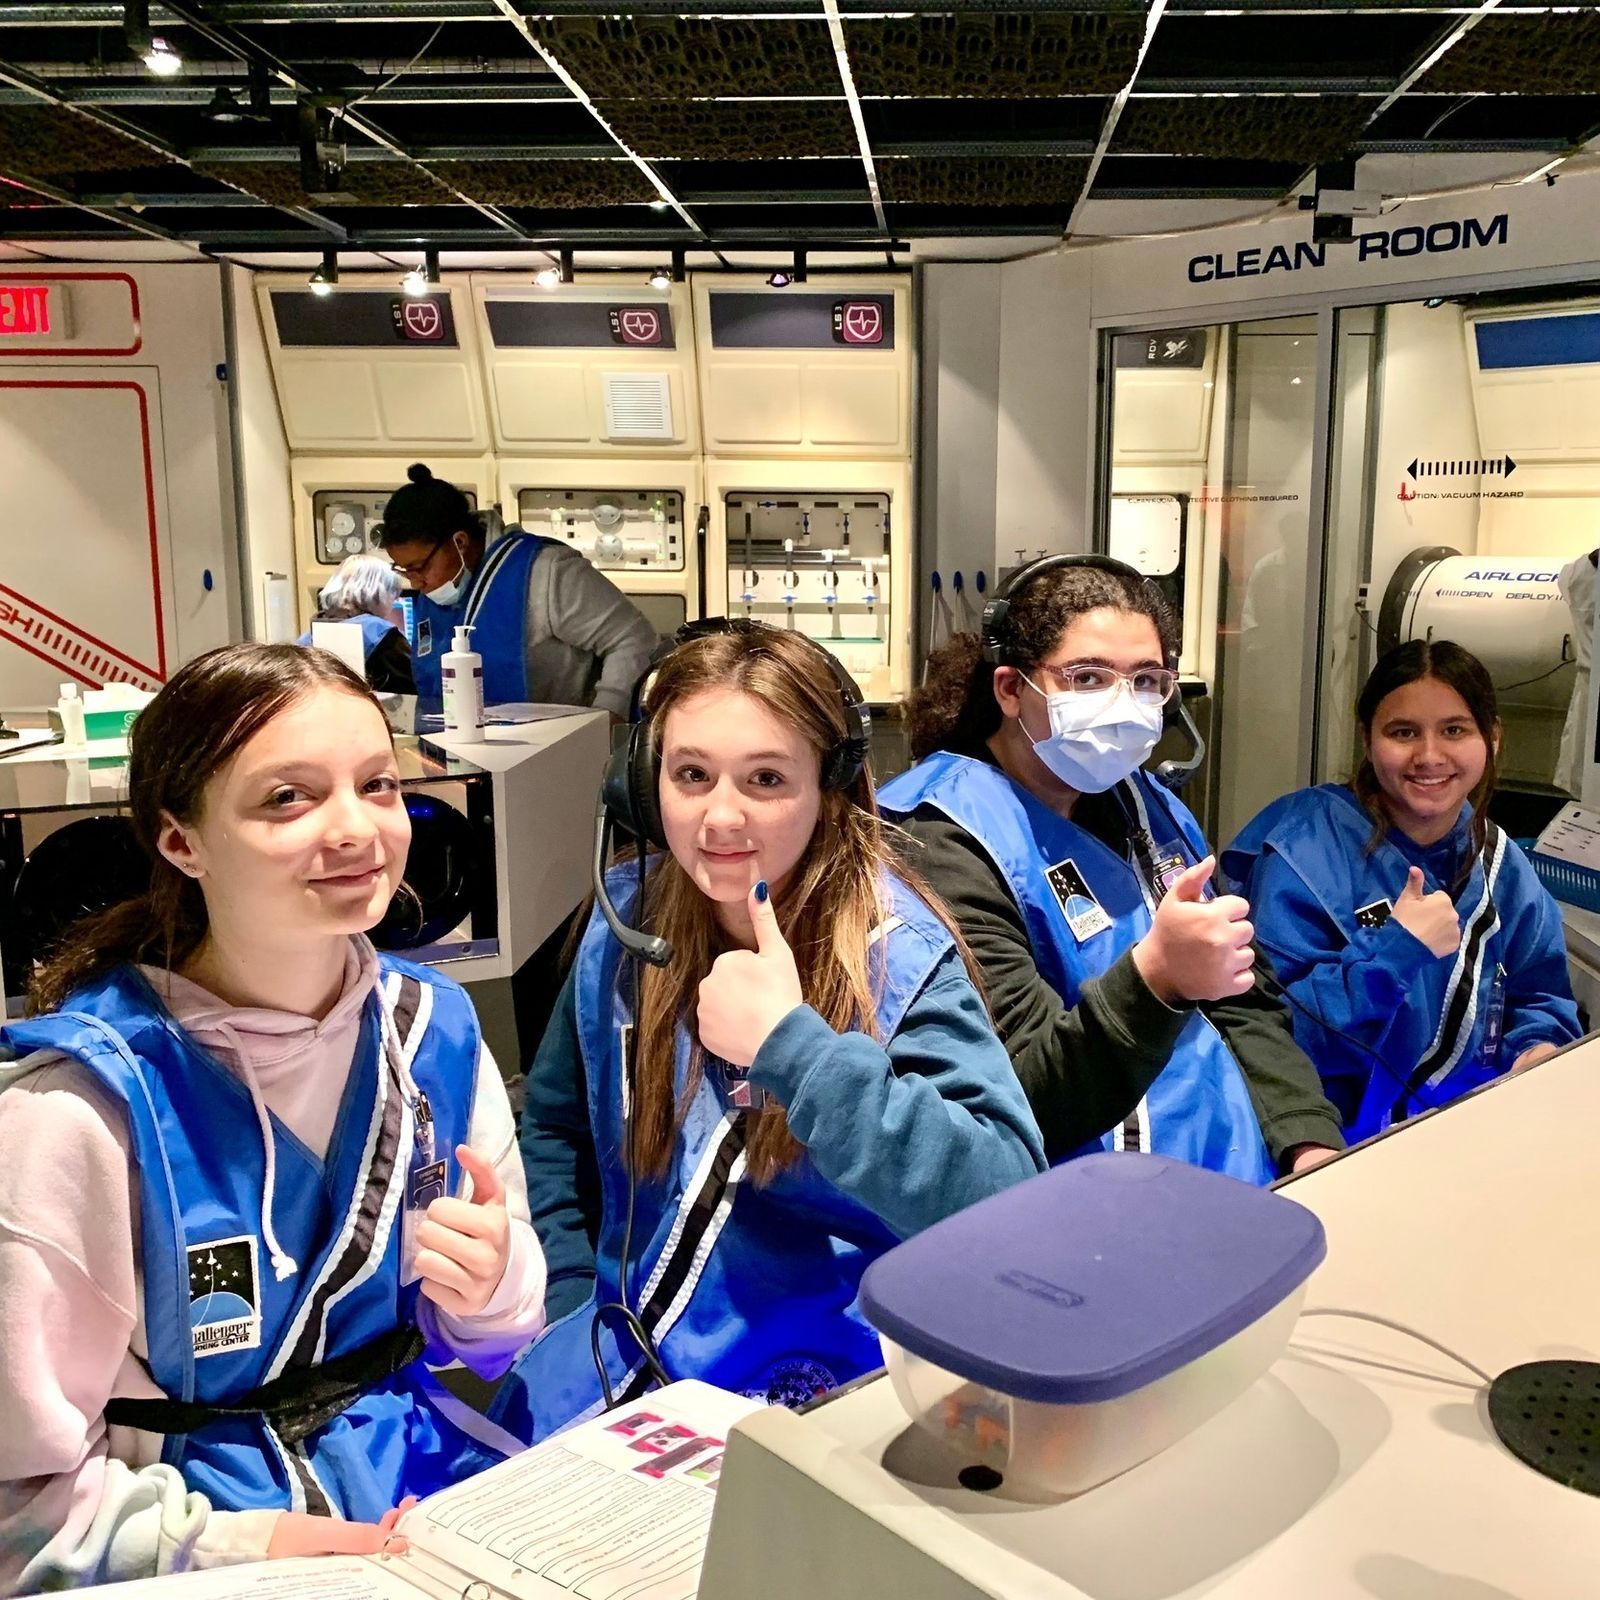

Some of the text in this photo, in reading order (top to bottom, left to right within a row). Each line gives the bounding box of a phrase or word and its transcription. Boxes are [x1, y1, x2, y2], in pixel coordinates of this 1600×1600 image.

[1188, 214, 1508, 283] CLEAN ROOM
[1147, 339, 1157, 360] ROV
[1258, 494, 1299, 502] REQUIRED
[1460, 590, 1554, 601] OPEN DEPLOY
[221, 1335, 249, 1346] CENTER
